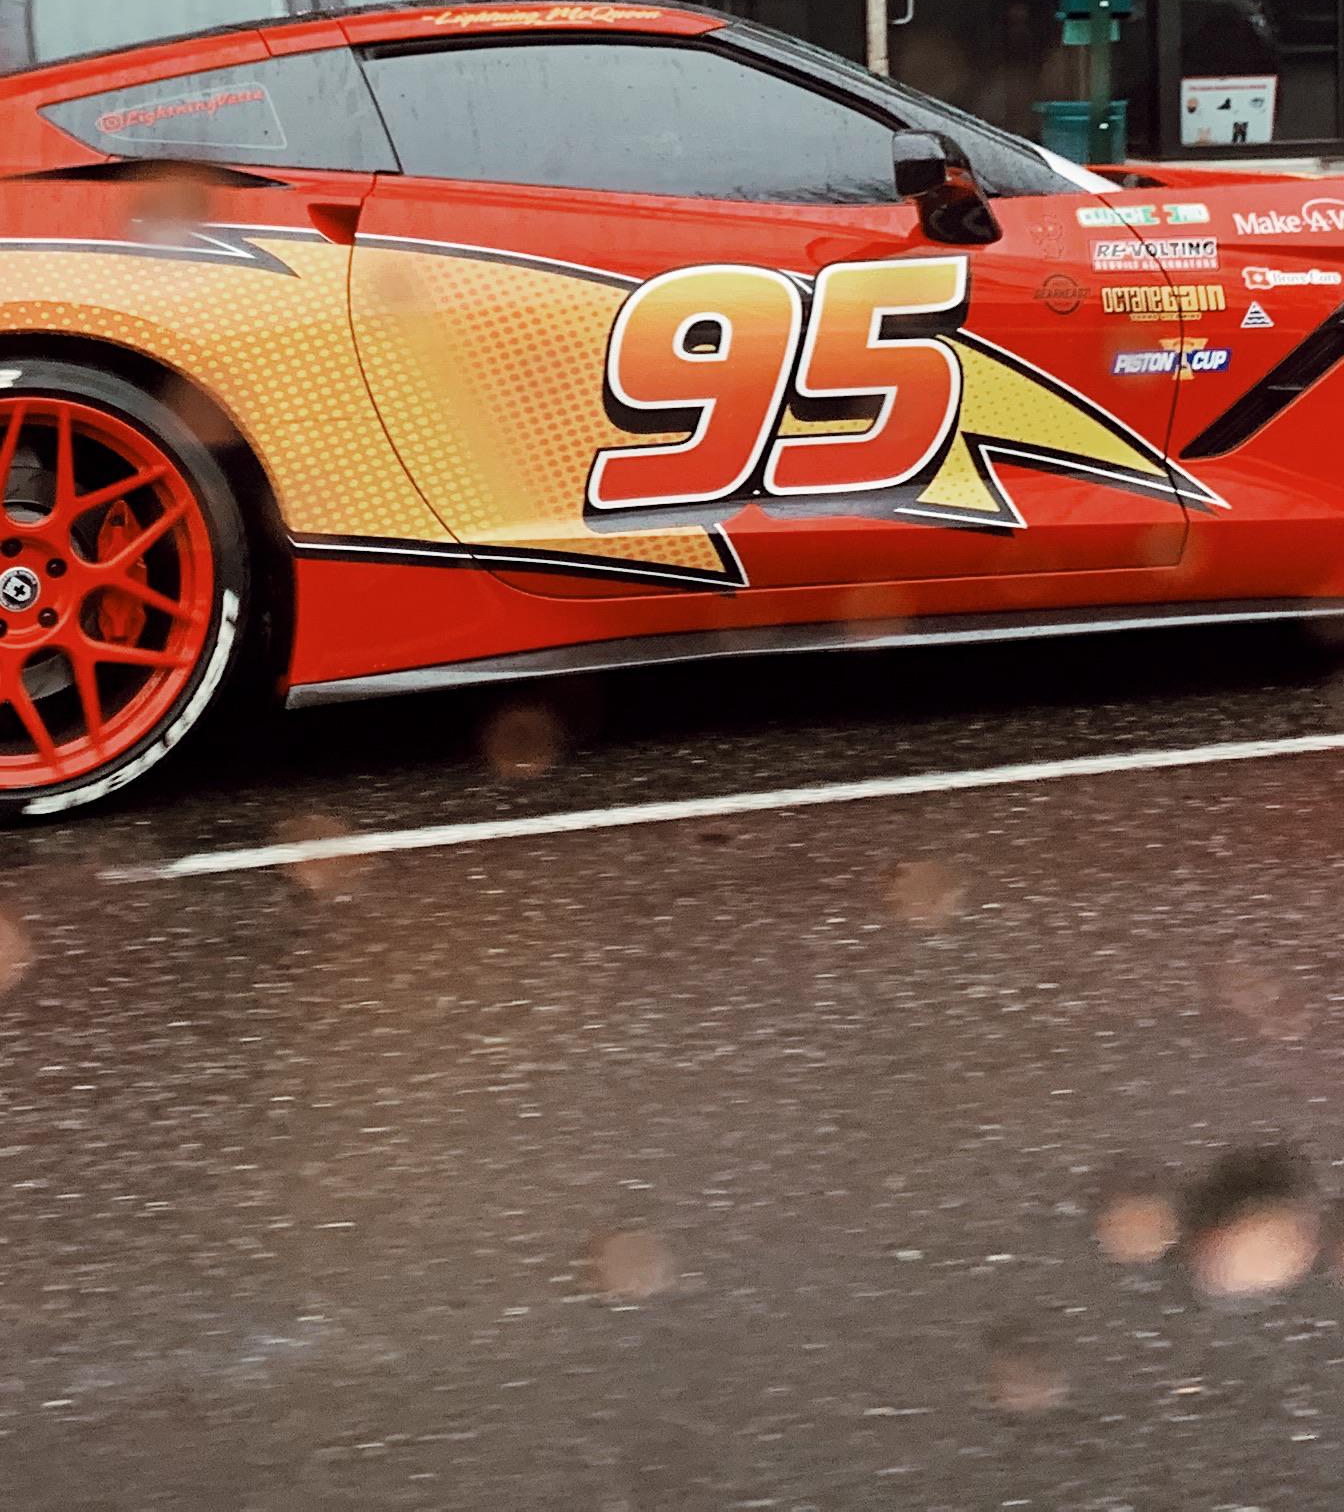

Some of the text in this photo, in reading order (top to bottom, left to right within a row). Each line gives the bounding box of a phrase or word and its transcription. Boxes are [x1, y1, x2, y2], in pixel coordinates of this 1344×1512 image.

[588, 255, 970, 510] 95
[1114, 350, 1228, 373] PISTON CUP
